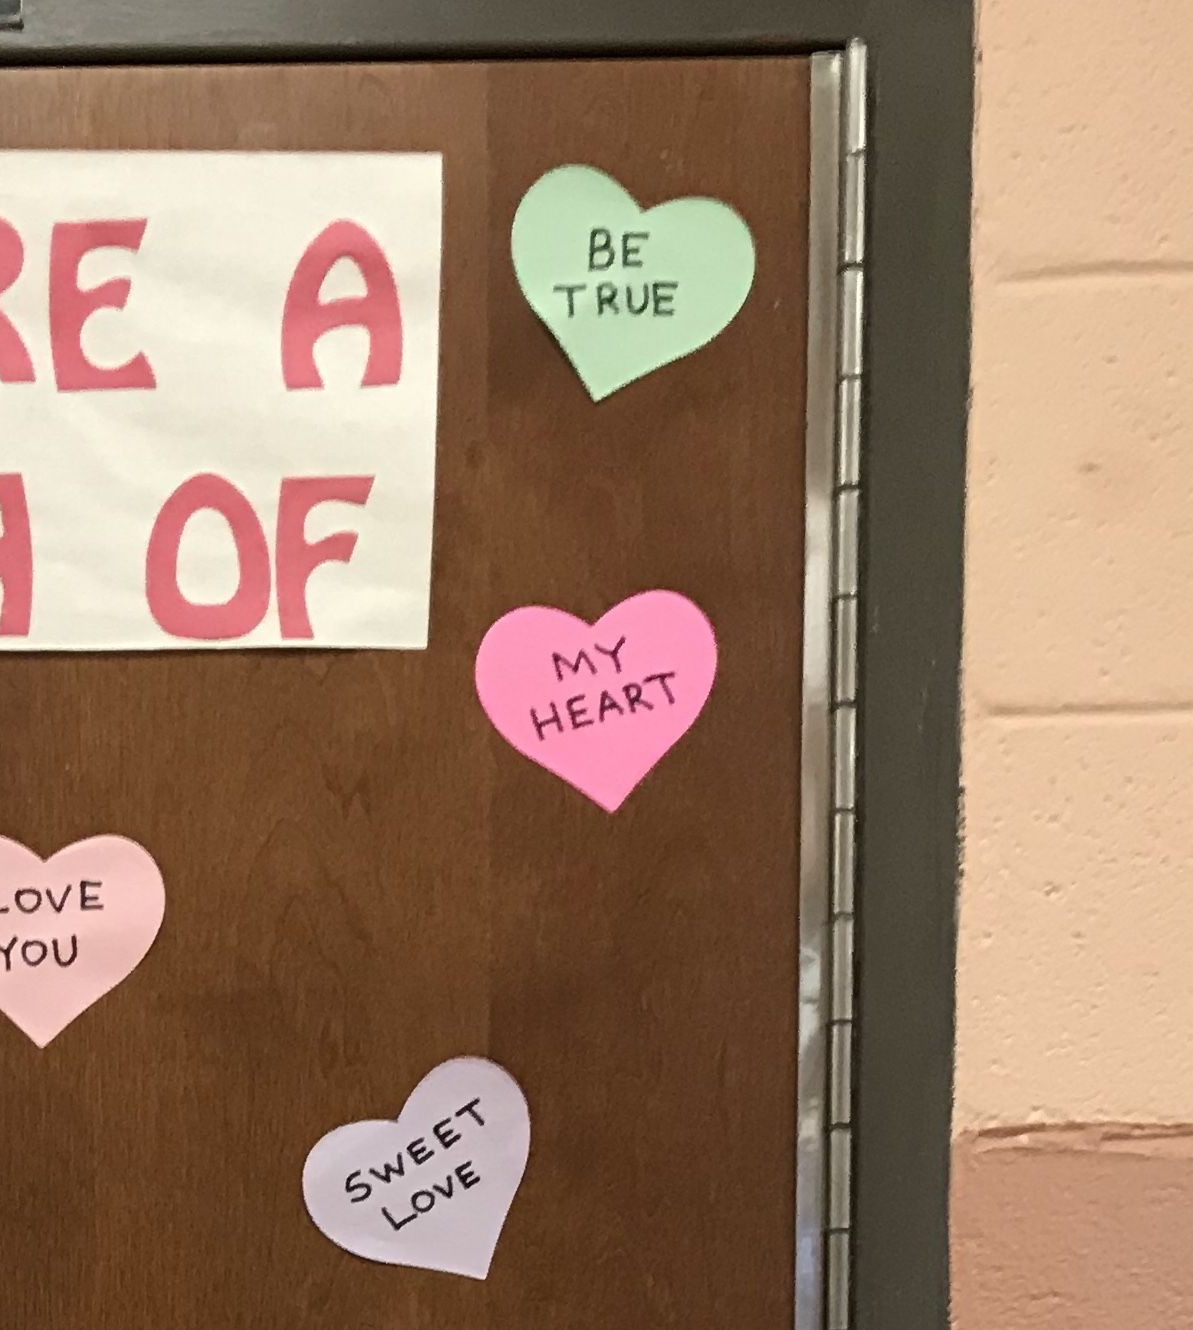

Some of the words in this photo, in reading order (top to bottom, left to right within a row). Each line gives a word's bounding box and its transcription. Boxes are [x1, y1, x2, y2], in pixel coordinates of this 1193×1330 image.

[588, 227, 650, 272] BE
[283, 223, 402, 388] A
[553, 281, 679, 318] TRUE
[146, 474, 372, 640] OF
[551, 636, 626, 682] MY
[530, 671, 676, 742] HEART
[344, 1097, 485, 1204] SWEET
[381, 1160, 481, 1232] LOVE
